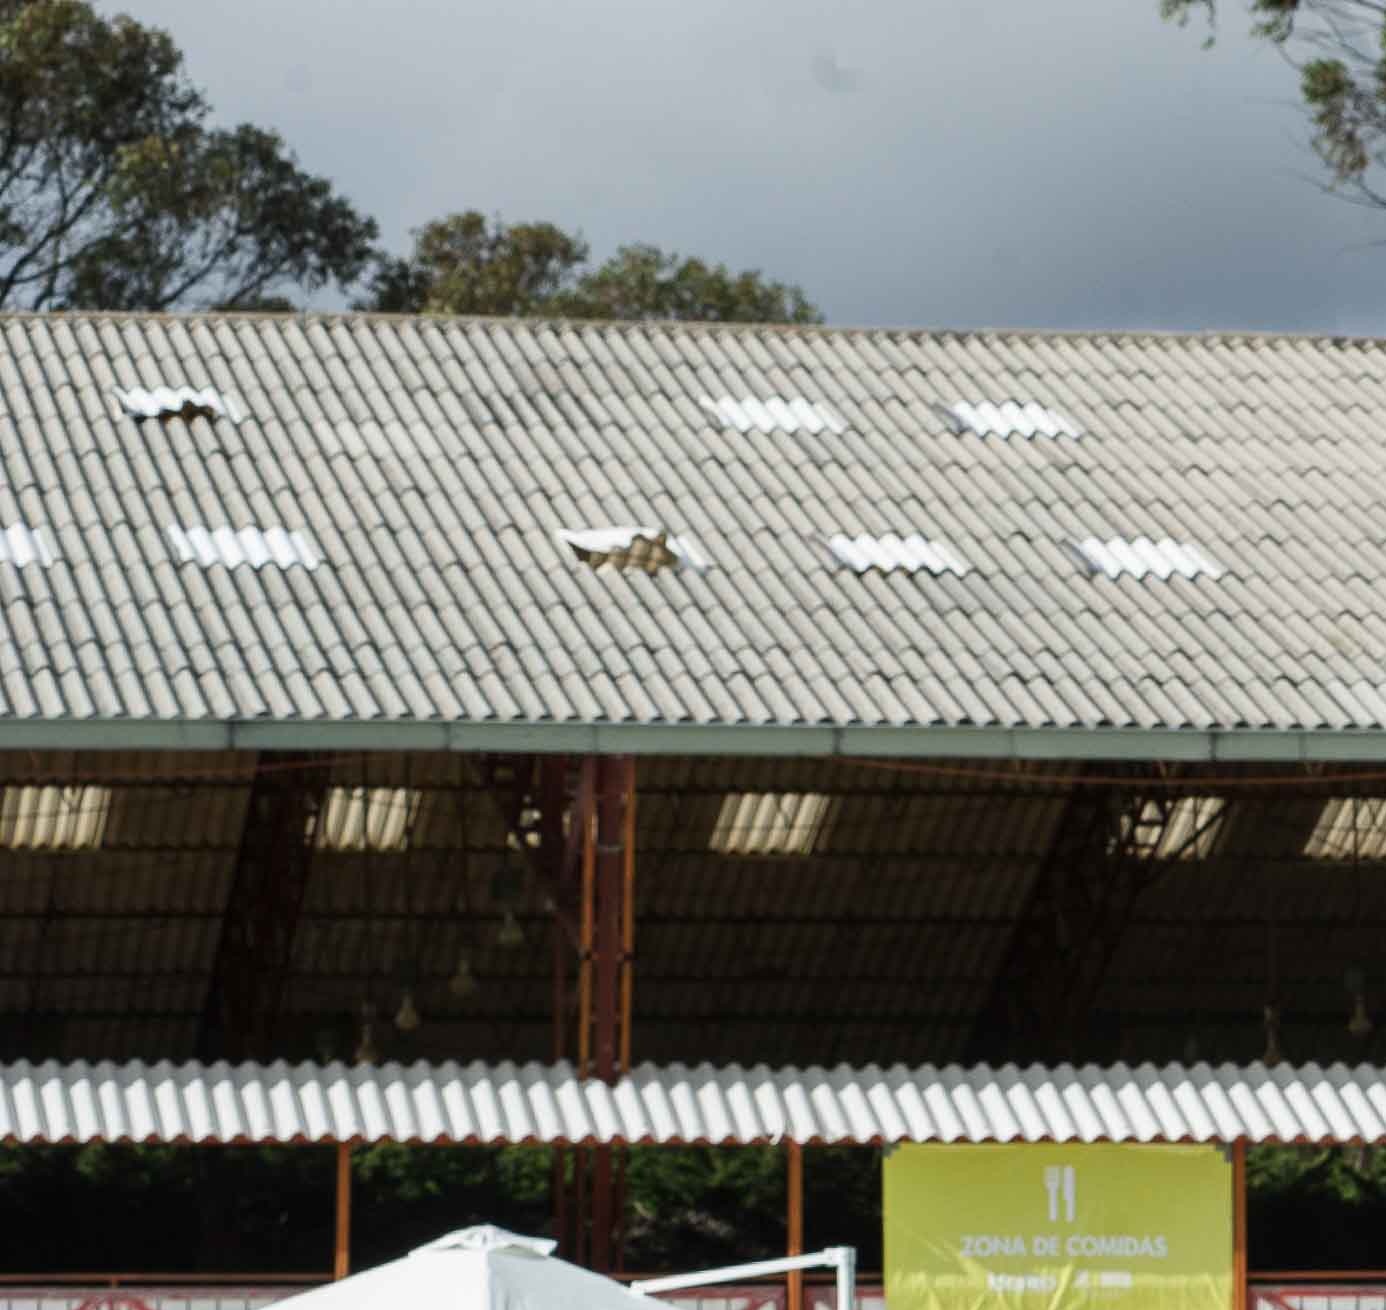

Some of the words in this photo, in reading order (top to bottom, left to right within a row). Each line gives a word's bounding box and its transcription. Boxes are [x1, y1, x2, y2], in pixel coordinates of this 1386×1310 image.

[960, 1235, 1027, 1257] ZONA
[1032, 1235, 1060, 1257] DE
[1067, 1234, 1169, 1258] COMIDAS
